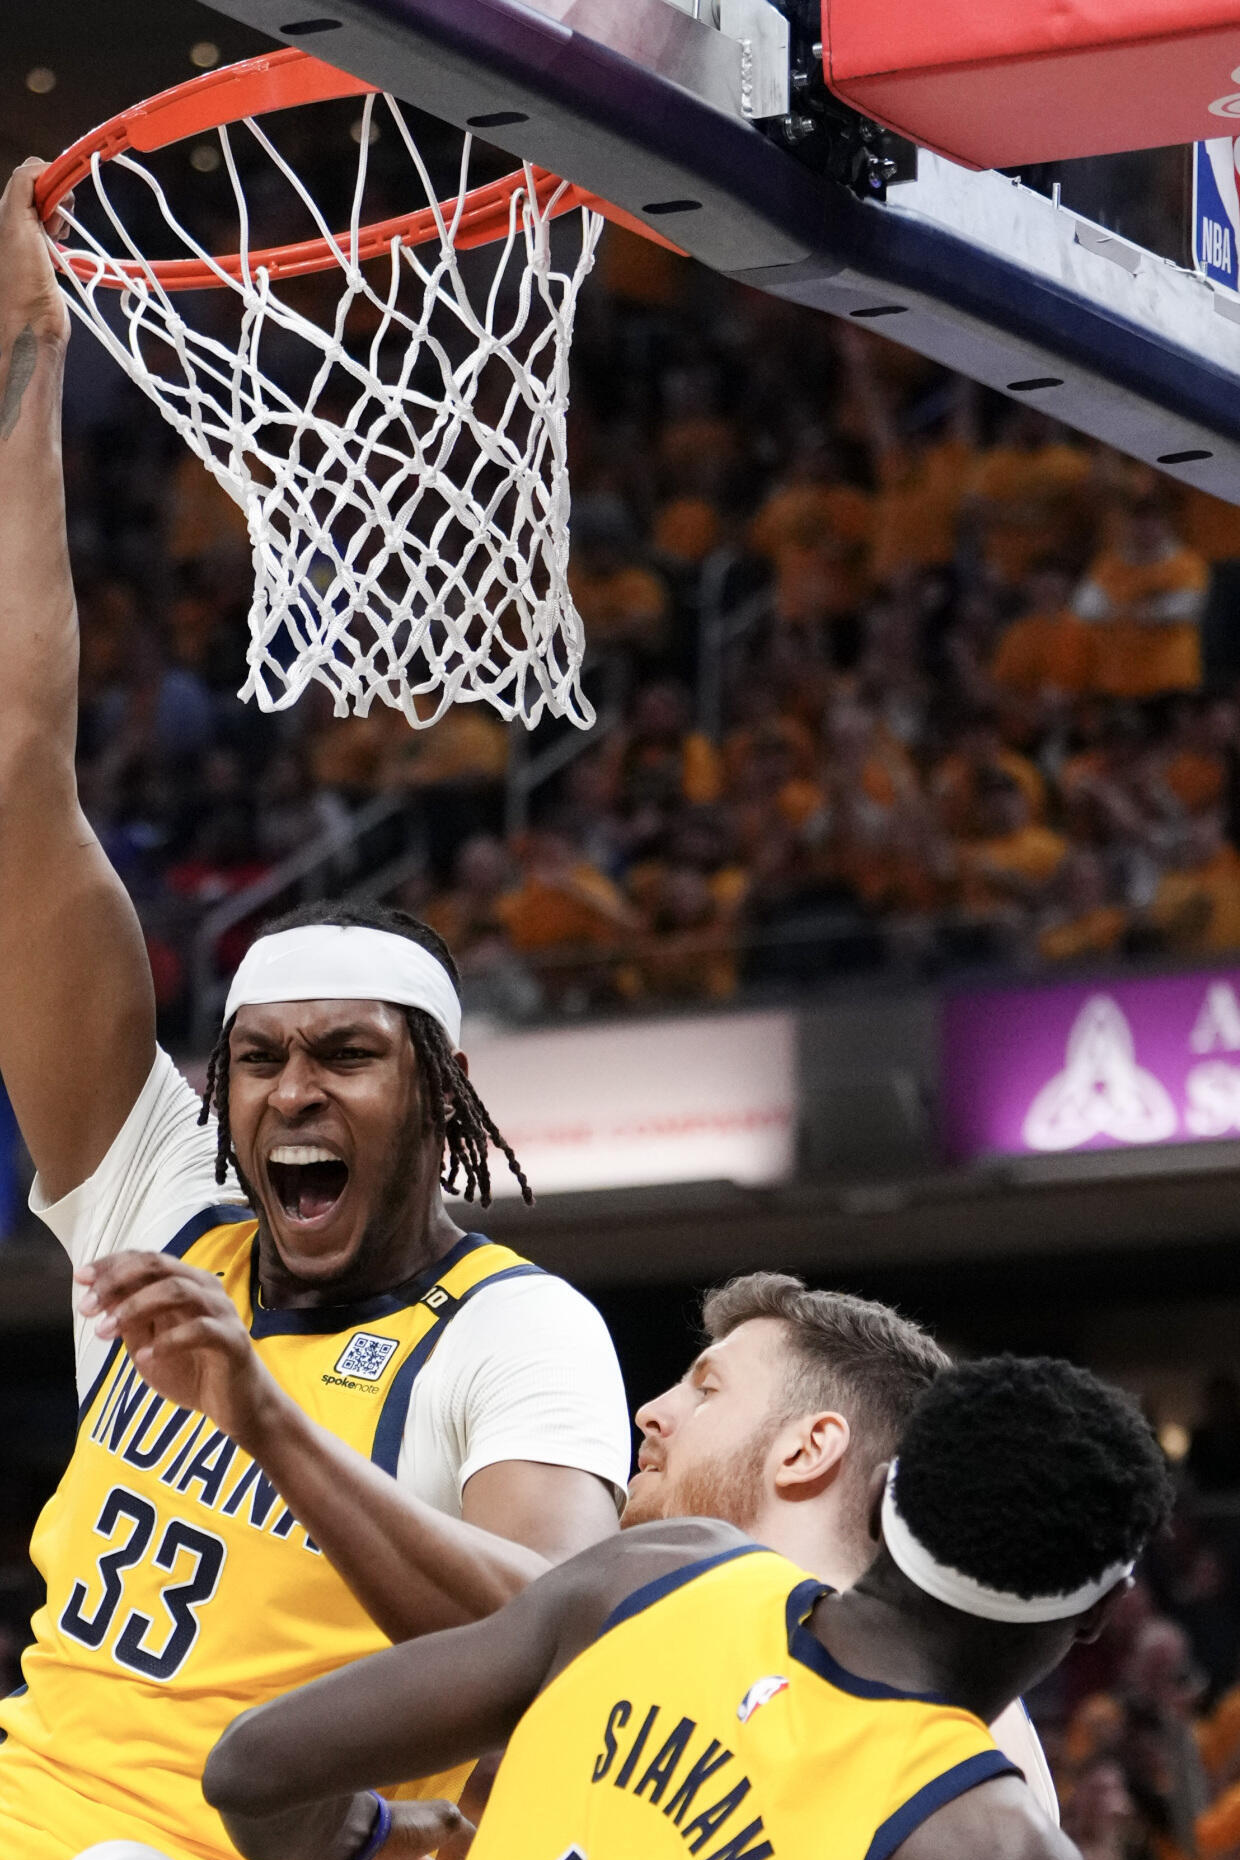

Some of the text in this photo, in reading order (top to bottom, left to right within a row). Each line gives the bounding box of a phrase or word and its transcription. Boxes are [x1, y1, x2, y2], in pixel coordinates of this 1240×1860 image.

[1202, 216, 1232, 274] NBA
[321, 1373, 380, 1395] spokenote
[59, 1484, 227, 1682] 33
